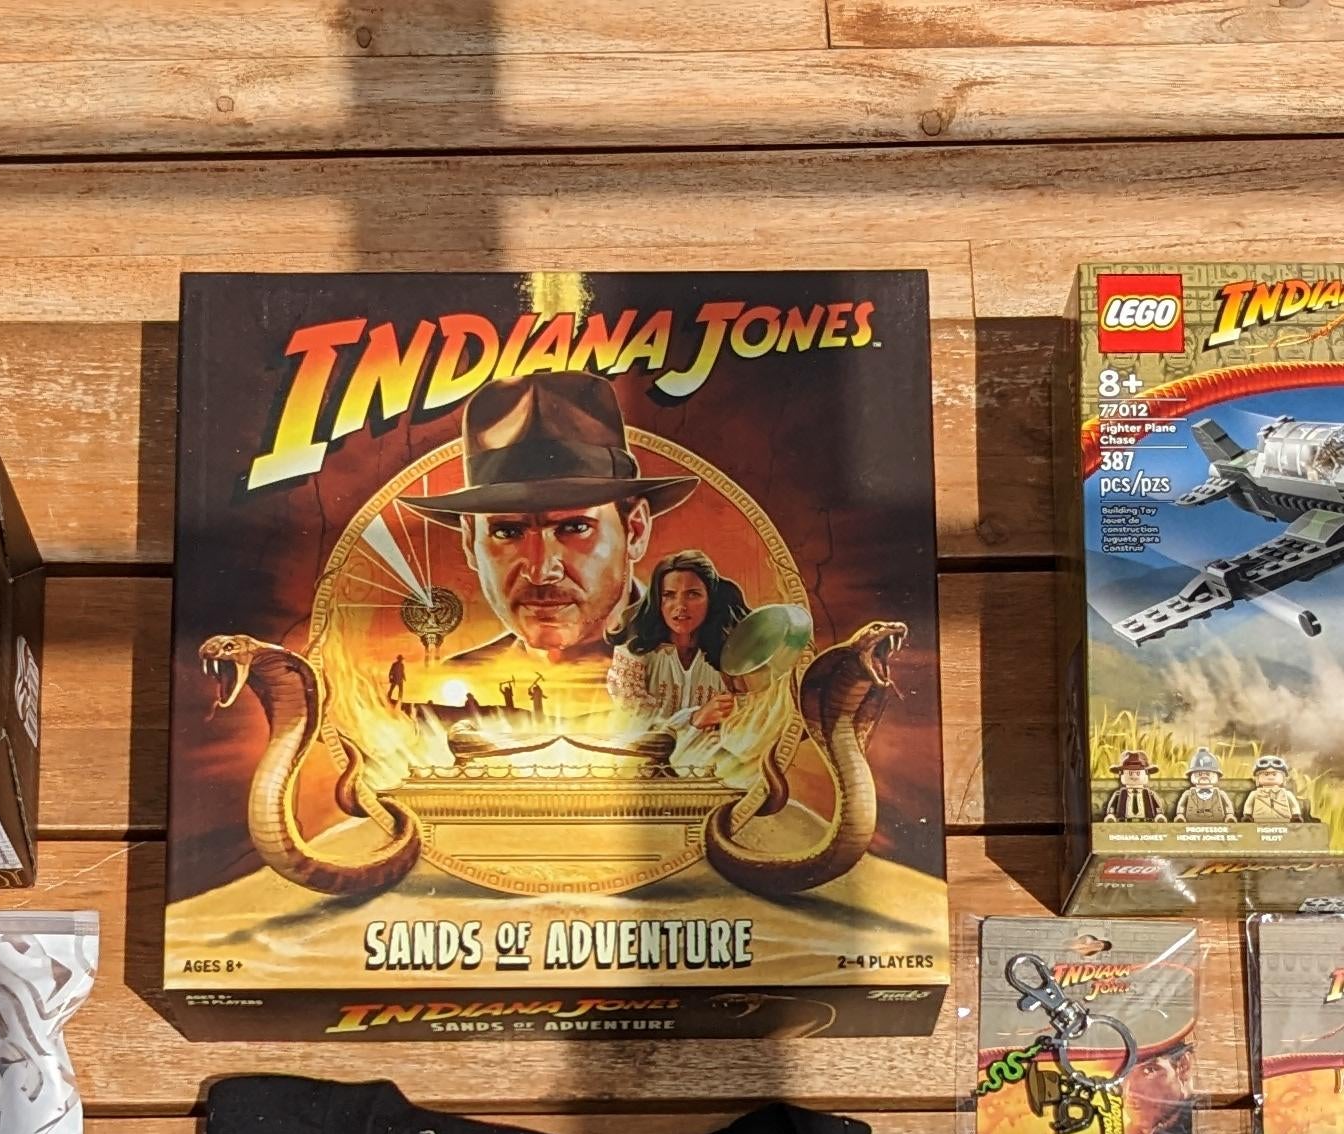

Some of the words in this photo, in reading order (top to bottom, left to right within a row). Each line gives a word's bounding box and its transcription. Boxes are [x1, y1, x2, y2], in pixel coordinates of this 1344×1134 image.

[1101, 294, 1179, 331] LEGO
[1099, 369, 1144, 398] 8+
[246, 311, 665, 491] INDIANA
[1099, 403, 1149, 417] 77012
[1100, 423, 1142, 435] Fighter
[1144, 423, 1177, 434] Plane
[1100, 435, 1137, 446] Chase
[1100, 451, 1135, 471] 387
[1100, 470, 1171, 497] pcs/pzs
[1101, 507, 1138, 516] Building
[1140, 507, 1157, 516] Toy
[1102, 517, 1126, 525] Jouet
[1128, 517, 1140, 525] de
[1102, 526, 1159, 534] construction
[1140, 536, 1160, 544] para
[363, 920, 484, 970] SANDS
[498, 921, 531, 966] OF
[543, 918, 755, 970] ADVENTURE
[182, 959, 222, 973] AGES
[226, 959, 244, 973] 8+
[868, 954, 934, 969] PLAYERS
[1053, 964, 1131, 990] INDIANA
[324, 1001, 558, 1033] INDIANA
[553, 997, 681, 1018] JONES
[430, 1021, 505, 1033] SANDS
[513, 1021, 535, 1032] OF
[544, 1019, 676, 1032] ADVENTURE
